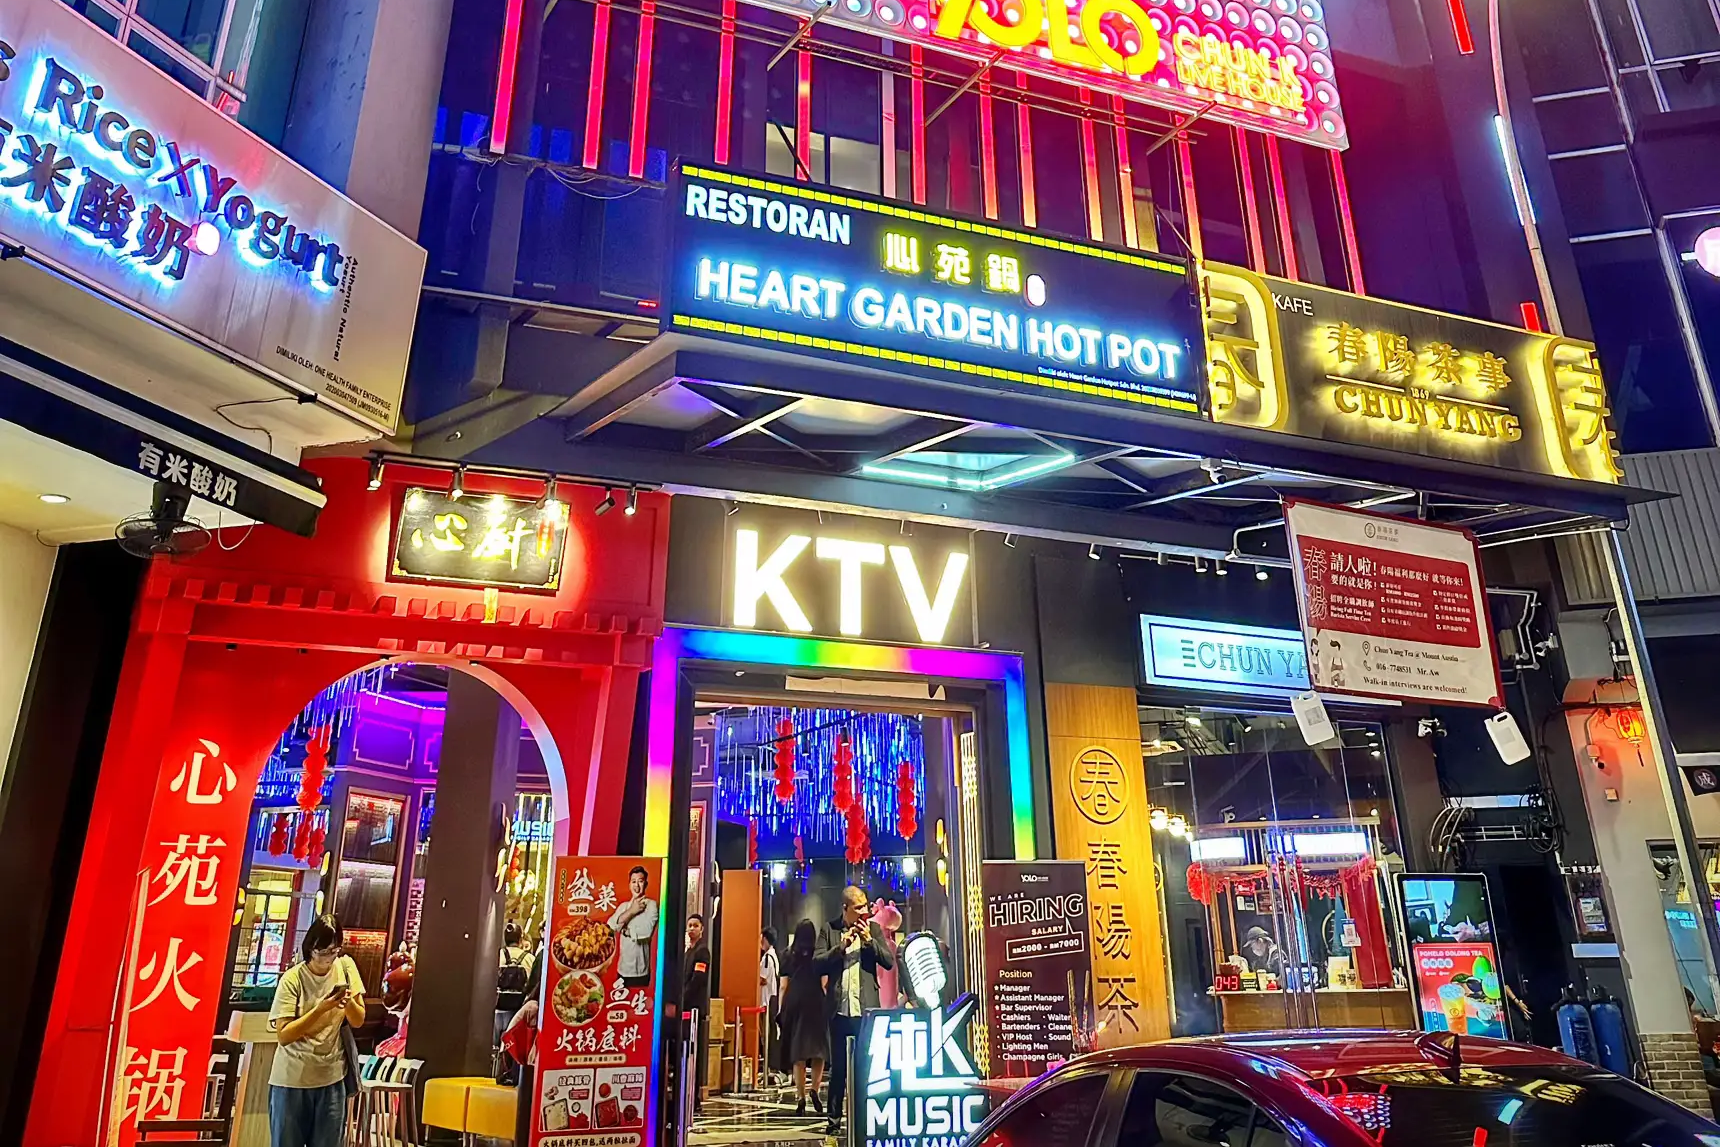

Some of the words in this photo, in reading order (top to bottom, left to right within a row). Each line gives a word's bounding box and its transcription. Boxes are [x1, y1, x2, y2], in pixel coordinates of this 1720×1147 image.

[1173, 33, 1272, 79] CHUN
[1276, 56, 1303, 87] K
[1176, 60, 1226, 92] LIVE
[1226, 72, 1307, 112] HOUSE
[35, 57, 156, 169] Rice
[201, 164, 344, 287] Yogurt
[686, 184, 850, 246] RESTORAN
[1271, 292, 1314, 316] KAFE
[697, 259, 846, 317] HEART
[850, 287, 1018, 350] GARDEN
[1027, 319, 1103, 365] HOT
[1107, 332, 1181, 380] POT
[1327, 320, 1512, 392] 春陽茶事
[276, 345, 298, 362] DIMILIKI
[298, 357, 313, 370] OLEH:
[315, 365, 326, 377] ONE
[326, 370, 346, 387] HEALTH
[346, 381, 363, 395] FAMILY
[363, 389, 392, 411] ENTERPRISE
[1334, 385, 1428, 427] CHUN
[1434, 401, 1523, 442] YANG
[138, 440, 239, 507] 有米酸奶
[732, 528, 970, 644] KTV
[1198, 641, 1272, 676] CHUN
[1277, 649, 1309, 679] YA
[1363, 676, 1388, 686] Walk-in
[1389, 679, 1420, 690] interviews
[567, 867, 618, 912] 盆菜
[1021, 874, 1038, 883] YOLO
[1007, 892, 1025, 900] ARE
[989, 893, 1084, 928] HIRING
[1031, 925, 1063, 936] SALARY
[999, 969, 1033, 979] Position
[1214, 975, 1239, 991] 043
[1000, 984, 1031, 993] Manager
[1034, 994, 1065, 1003] Manager
[1001, 1013, 1031, 1021] Cashiers
[1014, 1003, 1053, 1012] Supervisor
[554, 1023, 642, 1053] 火锅底料
[1001, 1022, 1041, 1031] Bartenders
[1001, 1033, 1014, 1041] VIP
[1015, 1033, 1033, 1041] Host
[1048, 1033, 1072, 1041] Sound
[1001, 1043, 1032, 1051] Lighting
[1002, 1053, 1045, 1062] Champagne
[866, 1094, 985, 1137] MUSIC
